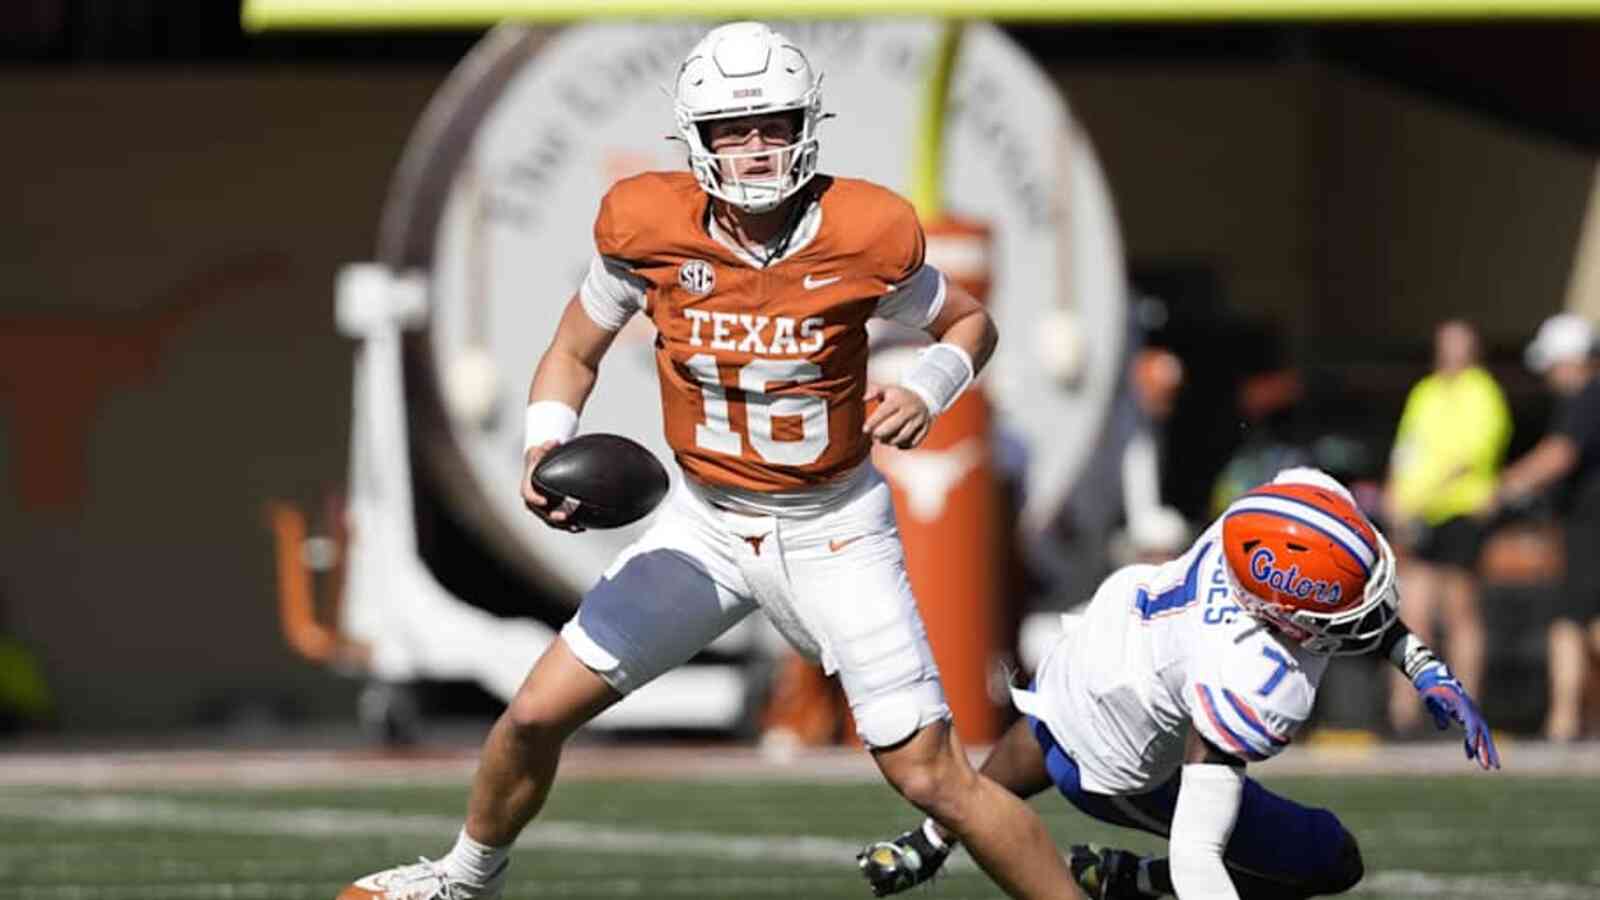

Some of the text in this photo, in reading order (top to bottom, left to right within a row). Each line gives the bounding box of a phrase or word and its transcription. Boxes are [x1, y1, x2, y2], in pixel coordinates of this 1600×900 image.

[680, 262, 714, 293] SEC
[683, 308, 825, 354] TEXAS
[686, 353, 830, 466] 16
[1250, 547, 1343, 604] Gators
[1257, 645, 1289, 696] 7
